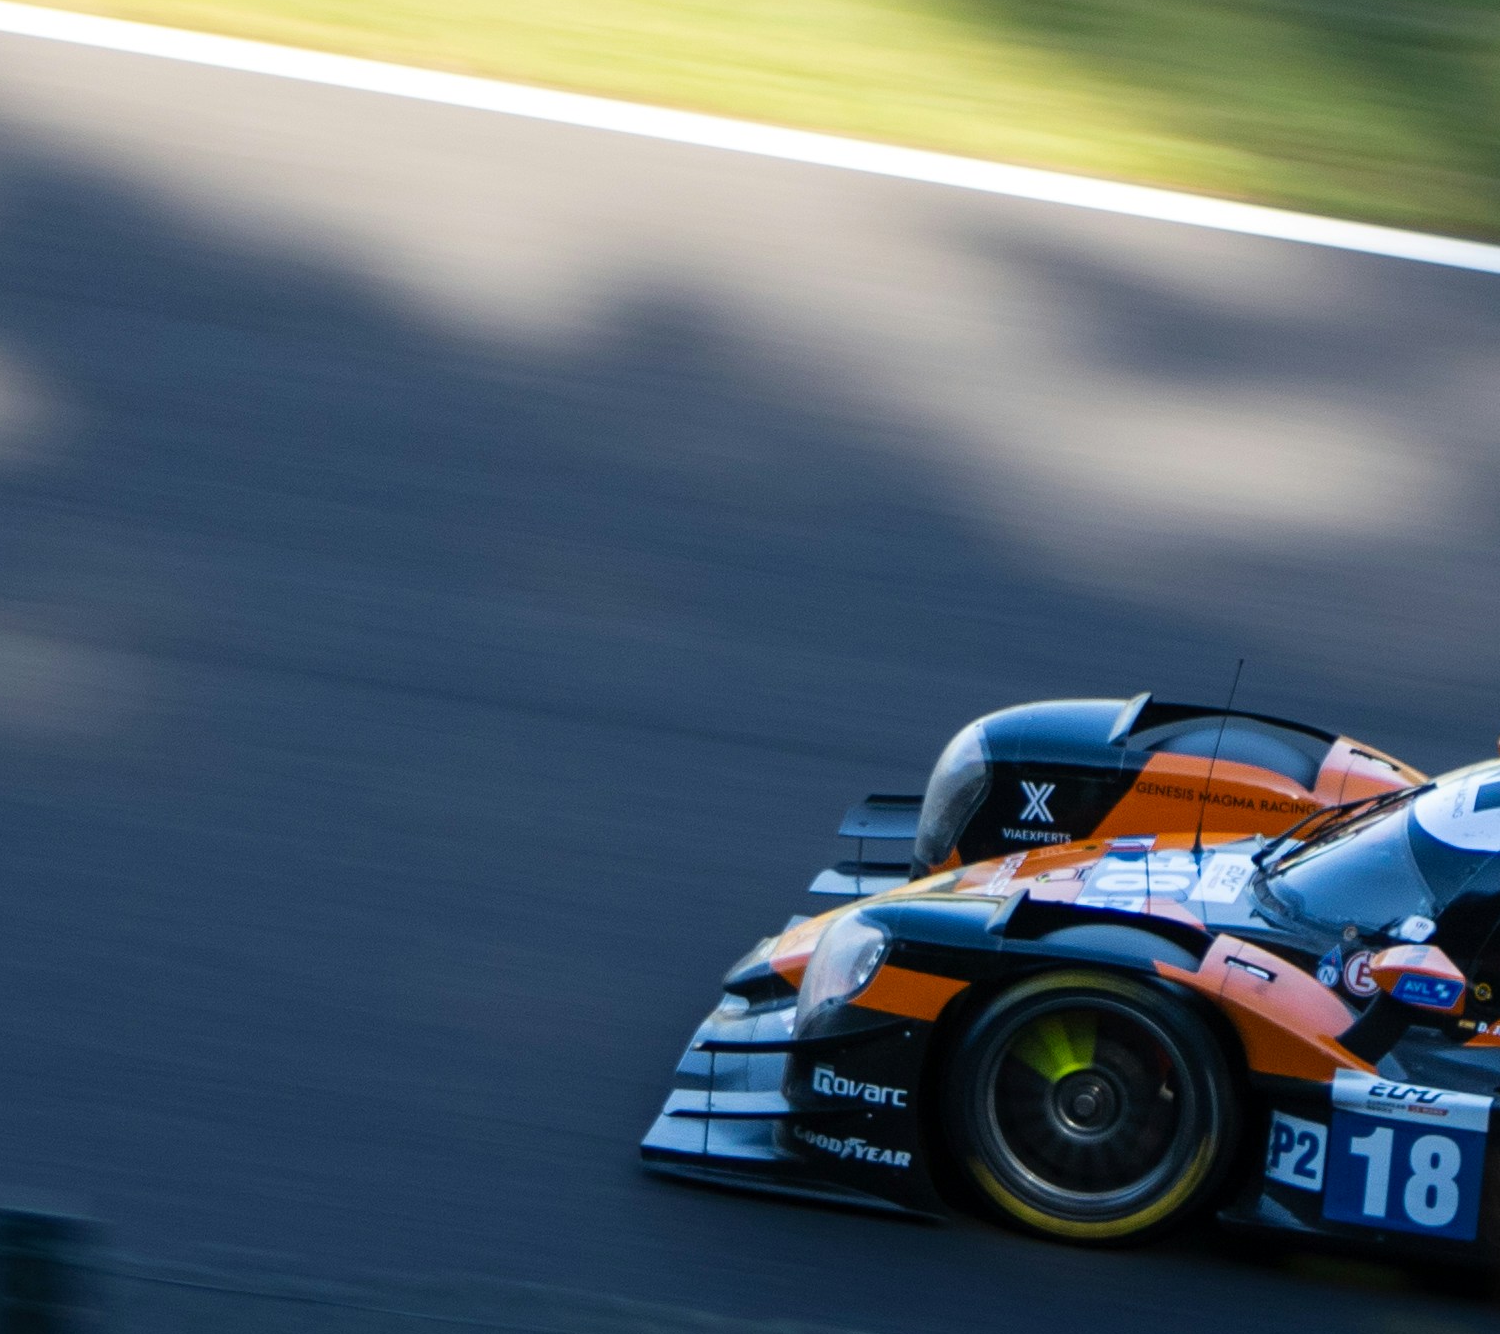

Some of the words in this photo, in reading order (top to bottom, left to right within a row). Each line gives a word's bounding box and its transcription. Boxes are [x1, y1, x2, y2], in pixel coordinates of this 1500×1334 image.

[1135, 780, 1194, 802] GENESIS
[1198, 789, 1255, 811] MAGMA
[1260, 799, 1318, 816] RACING
[1002, 827, 1073, 845] VIAEXPERTS
[1403, 979, 1431, 996] AVL
[1477, 1020, 1490, 1034] D.
[1270, 1120, 1320, 1181] P2
[1350, 1126, 1462, 1227] 18
